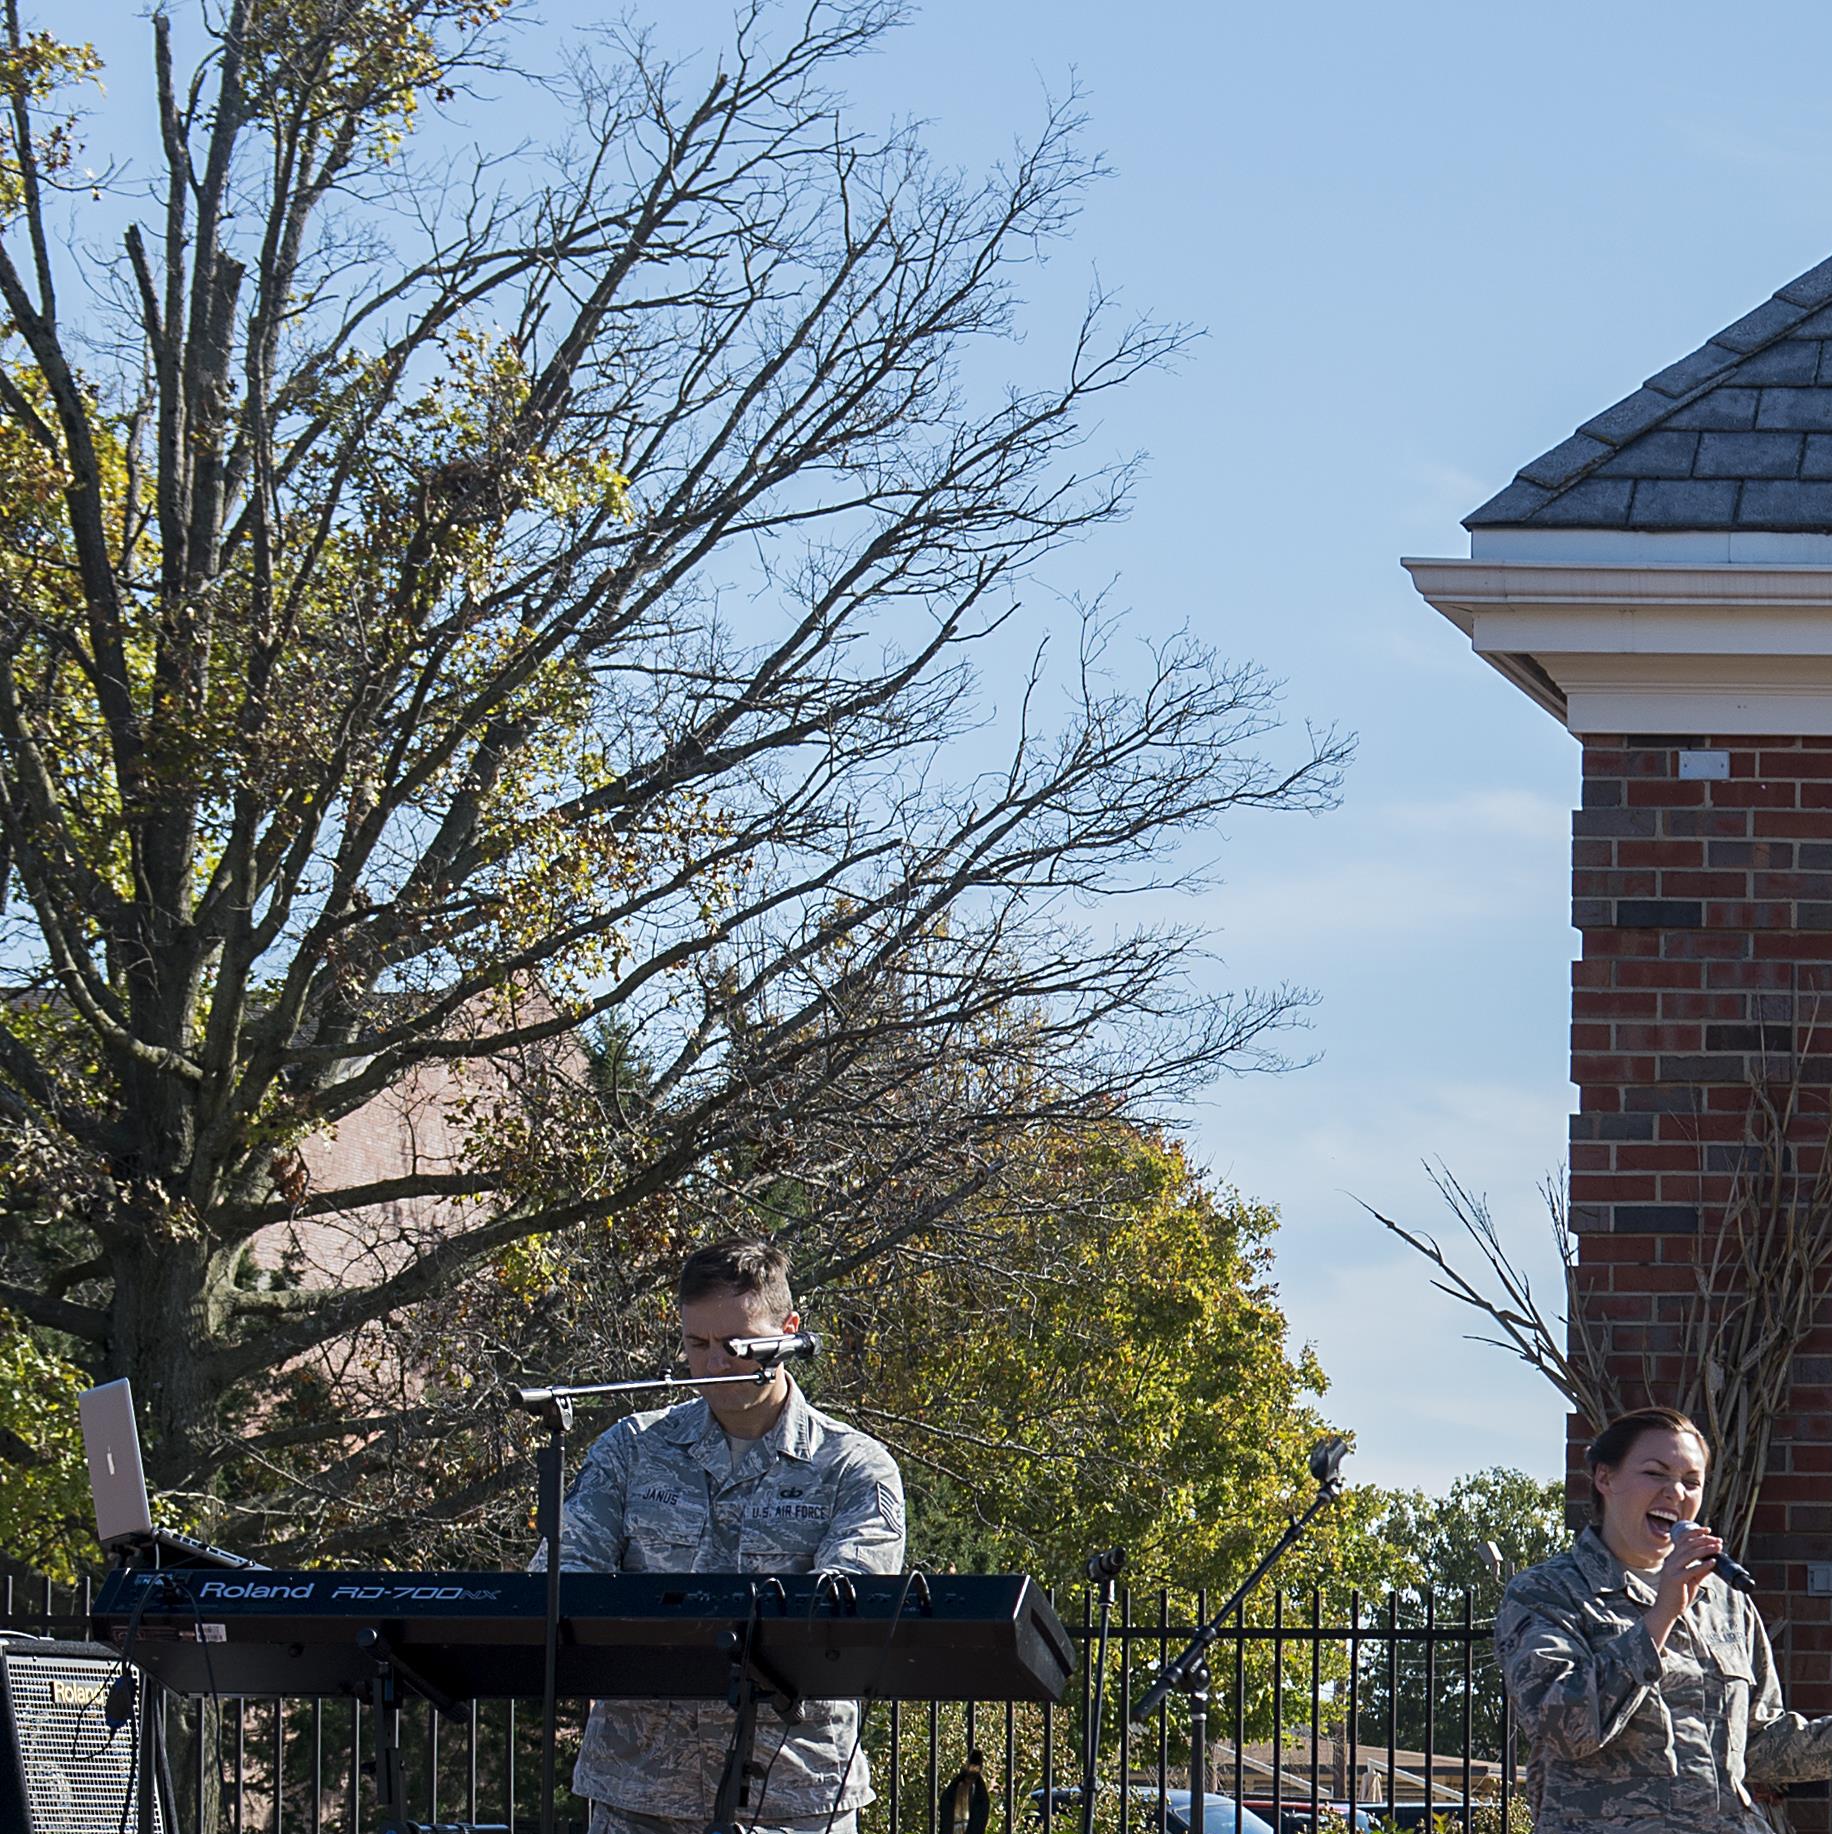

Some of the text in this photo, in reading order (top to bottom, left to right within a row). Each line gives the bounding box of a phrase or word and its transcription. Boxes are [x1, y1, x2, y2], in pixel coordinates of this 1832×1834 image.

[642, 1488, 678, 1506] JANUS
[752, 1505, 826, 1520] U.S. AIR FORCE
[200, 1582, 315, 1599] Roland
[53, 1680, 106, 1706] Roland
